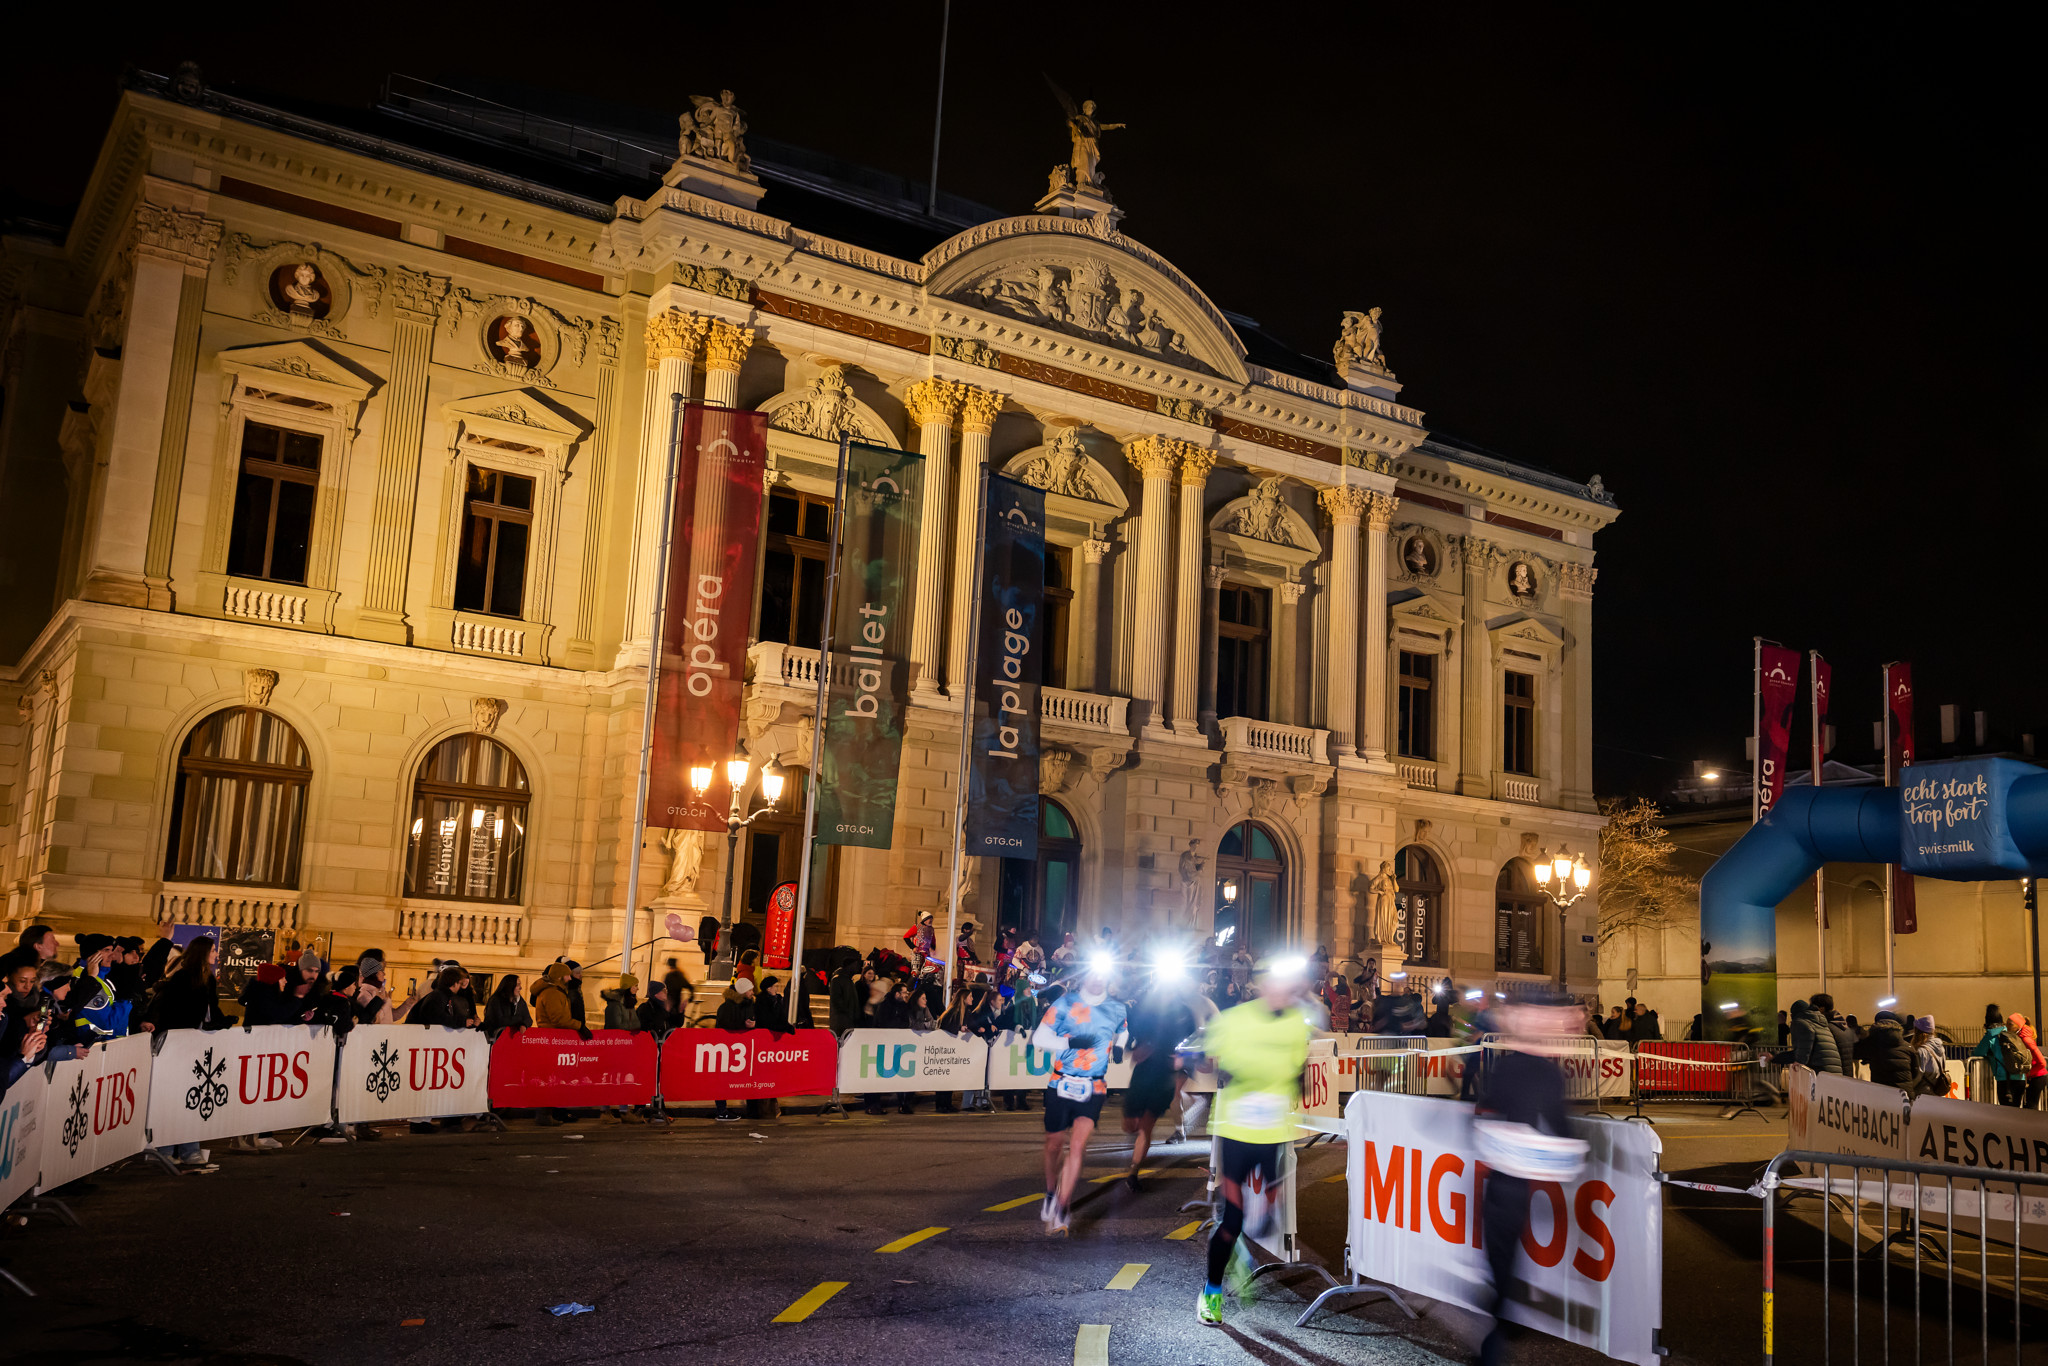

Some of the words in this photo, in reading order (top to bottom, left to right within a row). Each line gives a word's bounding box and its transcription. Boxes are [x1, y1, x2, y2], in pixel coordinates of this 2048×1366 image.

[682, 574, 723, 697] opéra
[845, 602, 887, 719] ballet
[992, 608, 1030, 715] plage
[988, 725, 1019, 760] la
[1758, 758, 1775, 819] éra
[1904, 778, 1940, 802] echt
[1942, 774, 1987, 799] stark
[667, 806, 707, 818] GTG.CH
[835, 823, 874, 835] GTG.CH
[1904, 802, 1942, 832] trop
[1945, 796, 1988, 827] fort
[984, 836, 1023, 847] GTG.CH
[1918, 840, 1975, 855] swissmilk
[1414, 898, 1426, 938] Plage
[1413, 942, 1423, 959] La
[614, 1037, 633, 1045] demain
[695, 1042, 747, 1073] m3
[757, 1049, 809, 1063] GROUPE
[924, 1045, 956, 1056] Hôpitaux
[408, 1047, 466, 1091] UBS
[557, 1053, 577, 1066] m3
[859, 1043, 917, 1078] HUG
[922, 1066, 951, 1076] Genève
[923, 1056, 971, 1065] Universitaires
[1009, 1044, 1053, 1077] HU
[238, 1050, 310, 1105] UBS
[1302, 1061, 1328, 1109] UBS
[94, 1067, 136, 1136] UBS
[1818, 1095, 1900, 1150] AESCHBACH
